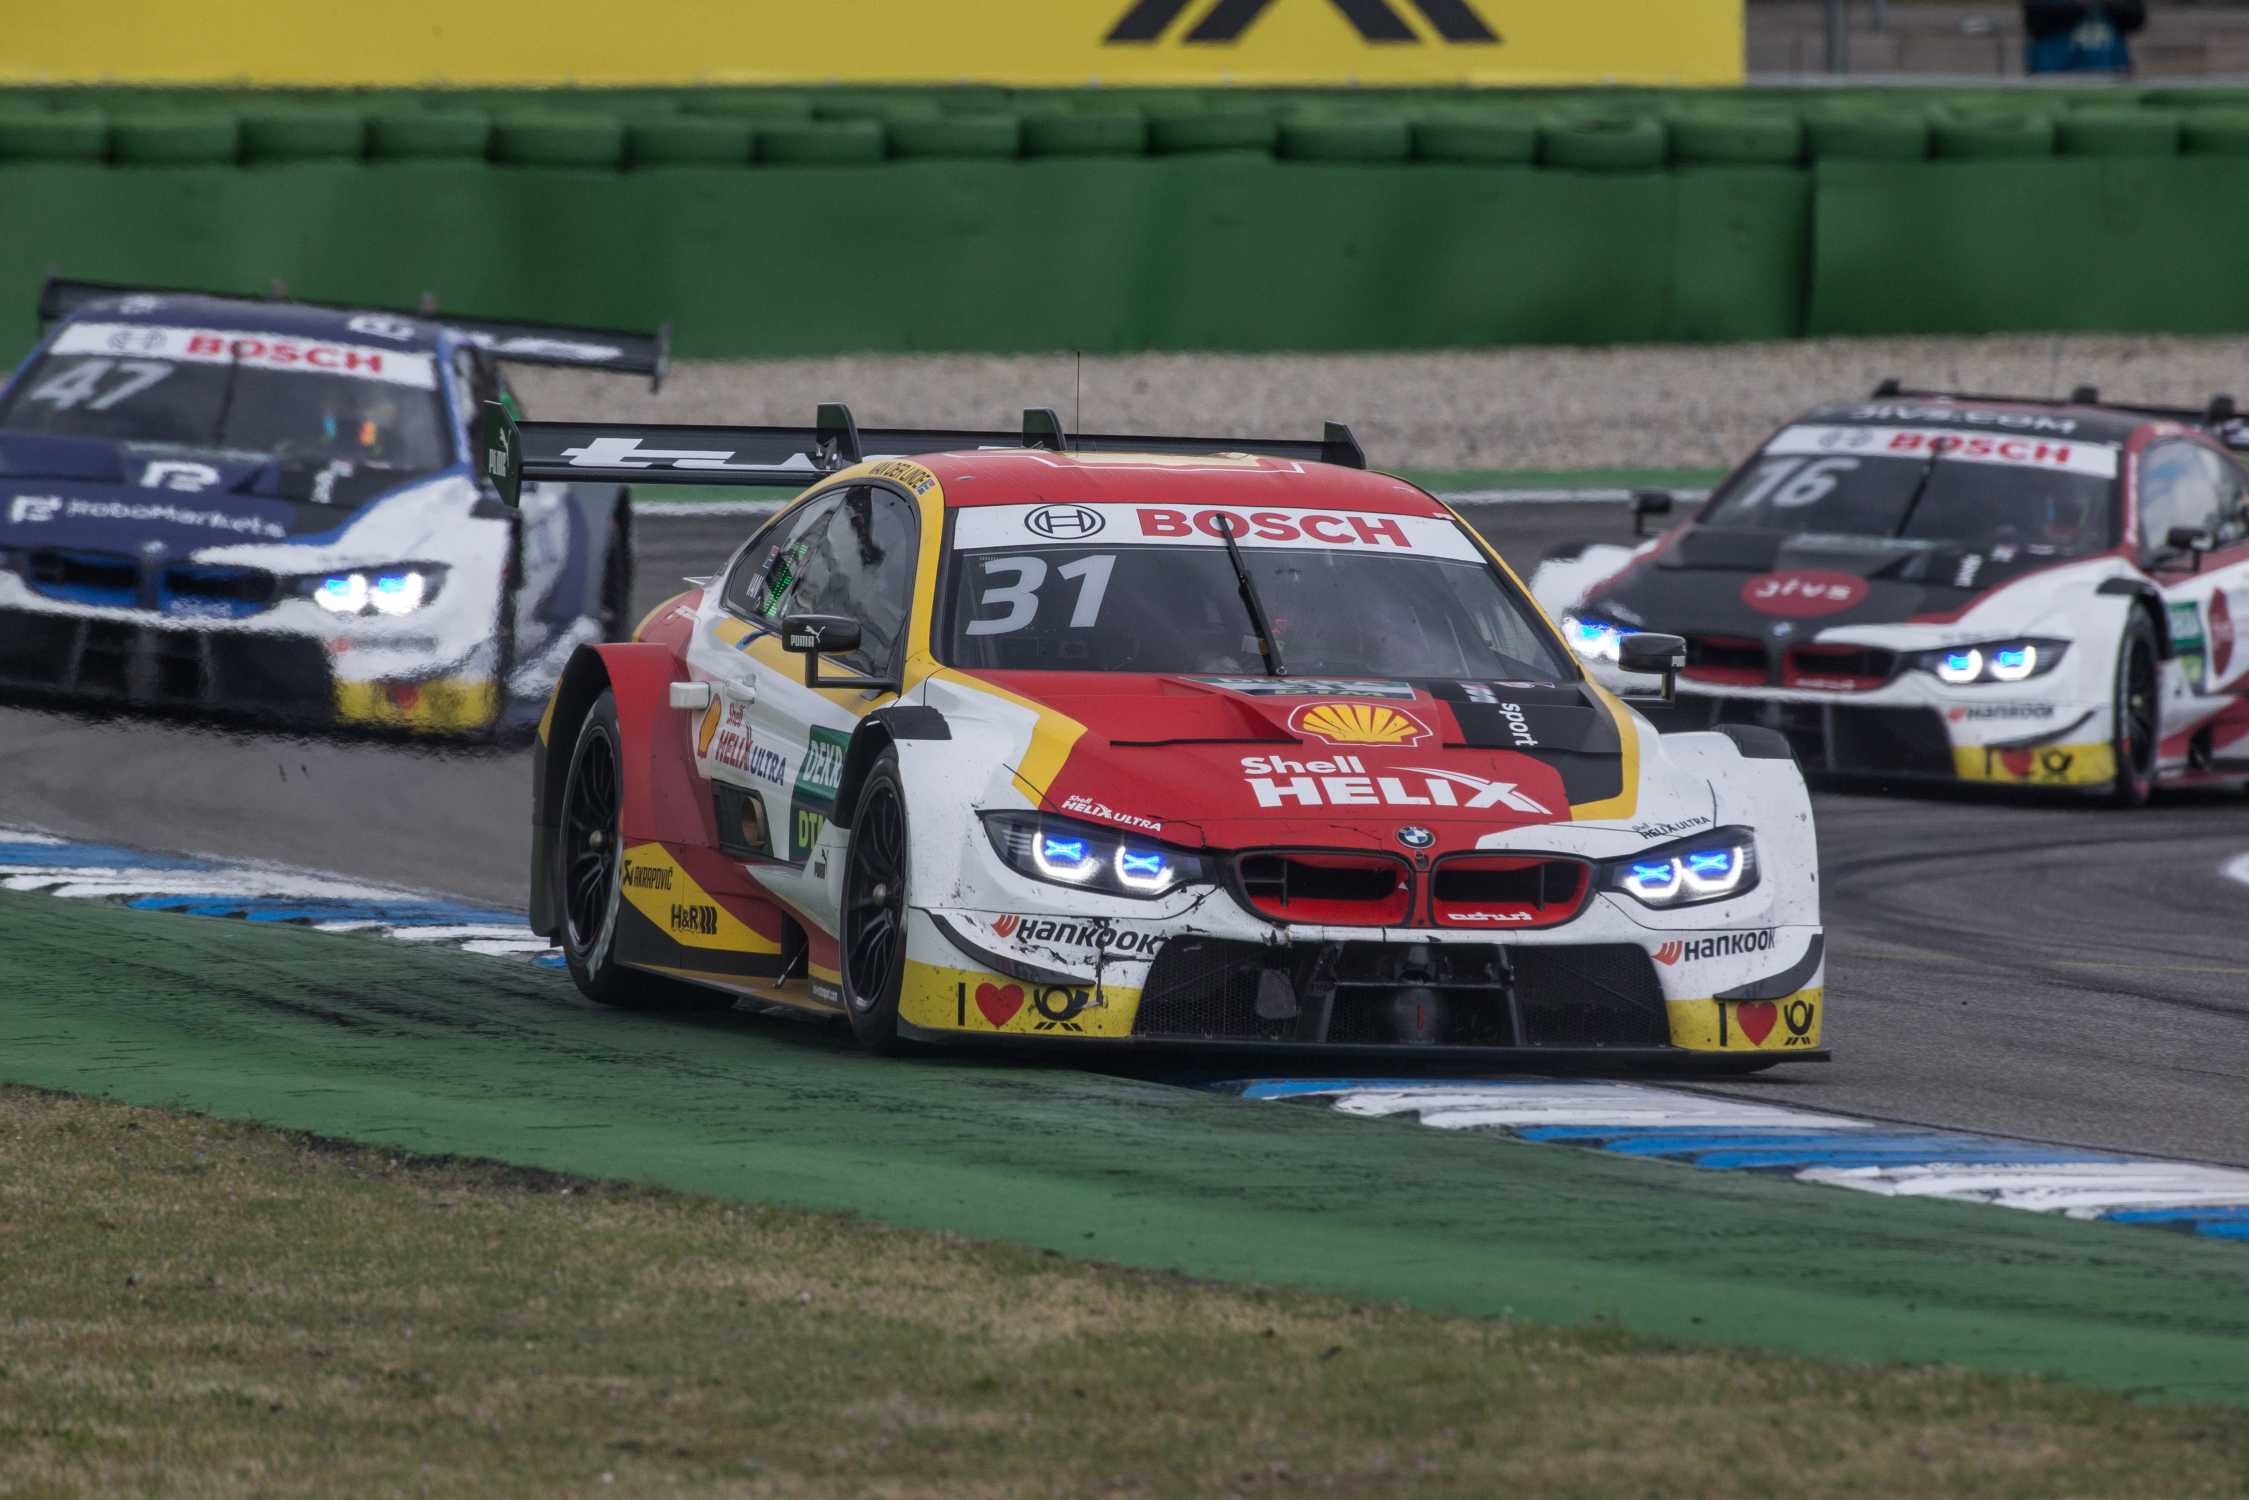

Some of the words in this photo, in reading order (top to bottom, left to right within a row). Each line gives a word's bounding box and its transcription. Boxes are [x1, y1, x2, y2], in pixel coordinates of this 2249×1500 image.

[186, 335, 383, 374] BOSCH
[30, 361, 173, 410] 47
[1888, 431, 2071, 464] BOSCH
[1741, 456, 1860, 508] 16
[1137, 508, 1412, 548] BOSCH
[965, 554, 1117, 636] 31
[790, 634, 815, 648] PUMA
[1499, 702, 1539, 747] sport
[750, 746, 787, 787] ULTRA
[802, 740, 846, 789] DEKR
[1240, 755, 1366, 775] Shell
[1244, 766, 1553, 815] HELIX
[1061, 799, 1113, 819] HELIX
[1113, 812, 1162, 832] ULTRA
[1675, 816, 1712, 831] ULTRA
[671, 904, 699, 930] H&R
